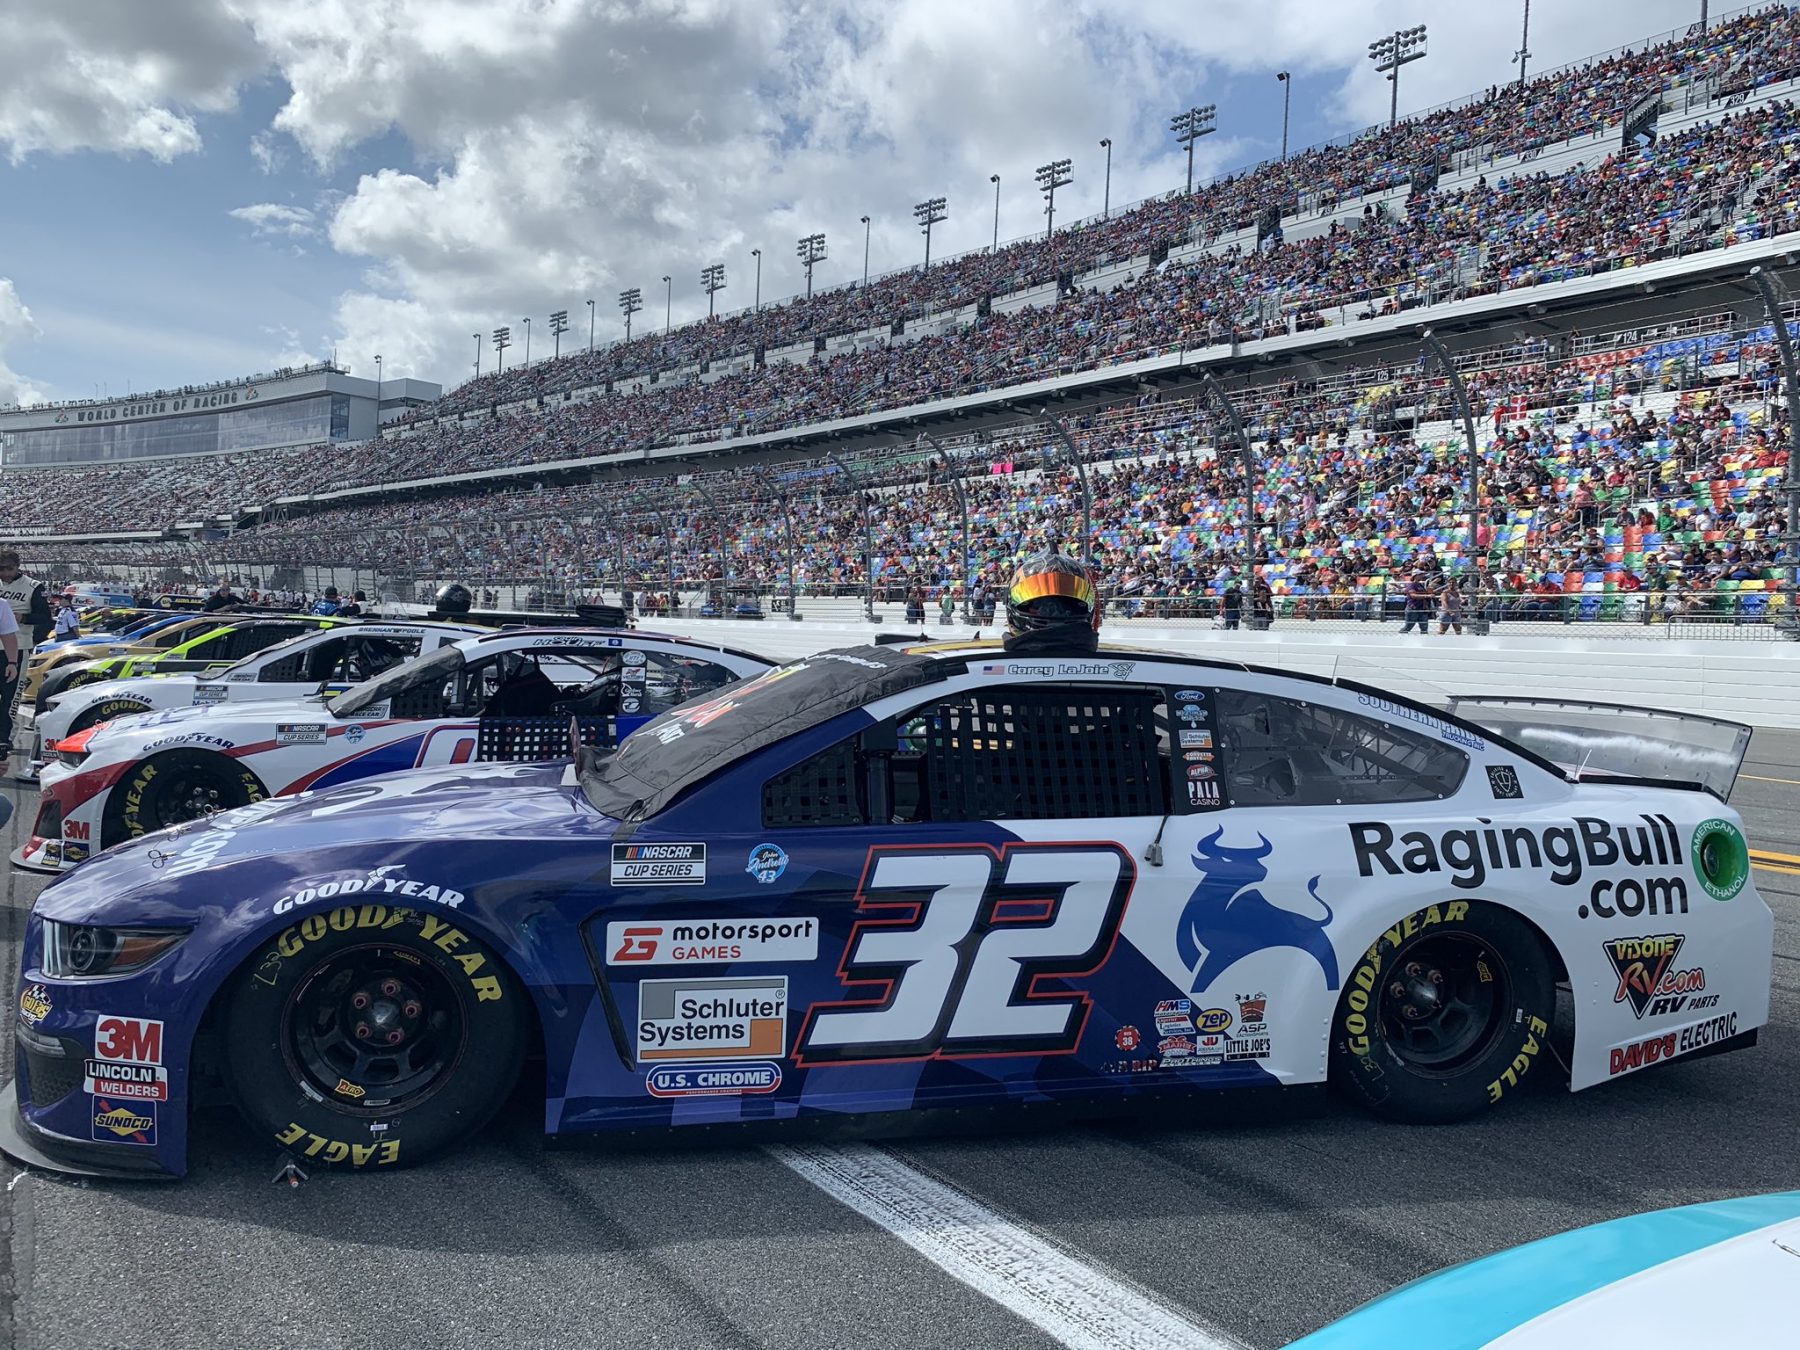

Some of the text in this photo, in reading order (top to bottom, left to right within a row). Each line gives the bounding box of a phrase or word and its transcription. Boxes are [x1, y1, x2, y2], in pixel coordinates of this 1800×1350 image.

[1729, 93, 1745, 105] 329
[1622, 331, 1638, 344] 124
[1376, 370, 1389, 382] 125
[77, 392, 238, 422] WORLD CENTER OF RACING
[1007, 664, 1109, 678] Corey LaJoie
[1358, 692, 1439, 728] SOUTHERN
[143, 733, 235, 751] GOODYEAR
[1187, 781, 1220, 799] PALA
[64, 819, 91, 840] 3M
[1693, 821, 1736, 854] AMERICAN
[641, 846, 693, 859] NASCAR
[1348, 814, 1684, 889] RagingBull
[623, 864, 693, 877] CUP SERIES
[758, 869, 777, 883] 43
[272, 864, 465, 915] GOODYEAR
[1704, 873, 1746, 898] ETHANOL
[1578, 876, 1689, 919] .com
[672, 920, 813, 943] motorsport
[277, 903, 503, 1002] GOODYEAR
[672, 945, 742, 960] GAMES
[800, 846, 1129, 1056] 32
[1345, 901, 1469, 1056] GOODYEAR
[681, 998, 784, 1019] Schluter
[1156, 999, 1191, 1012] HMS
[1649, 995, 1720, 1016] RV PARTS
[639, 1022, 745, 1047] Systems
[1237, 1023, 1267, 1034] ASP
[97, 1018, 162, 1063] 3M
[1225, 1039, 1249, 1054] LITTLE
[1250, 1038, 1271, 1052] JOE'S
[1610, 1012, 1738, 1075] DAVID'S ELECTRIC
[1486, 1015, 1548, 1104] EAGLE
[88, 1062, 152, 1082] LINCOLN
[658, 1071, 771, 1088] U.S. CHROME
[100, 1081, 160, 1097] WELDERS
[340, 1084, 361, 1095] AERO
[97, 1114, 152, 1130] SUNOCO
[273, 1122, 402, 1166] EAGLE
